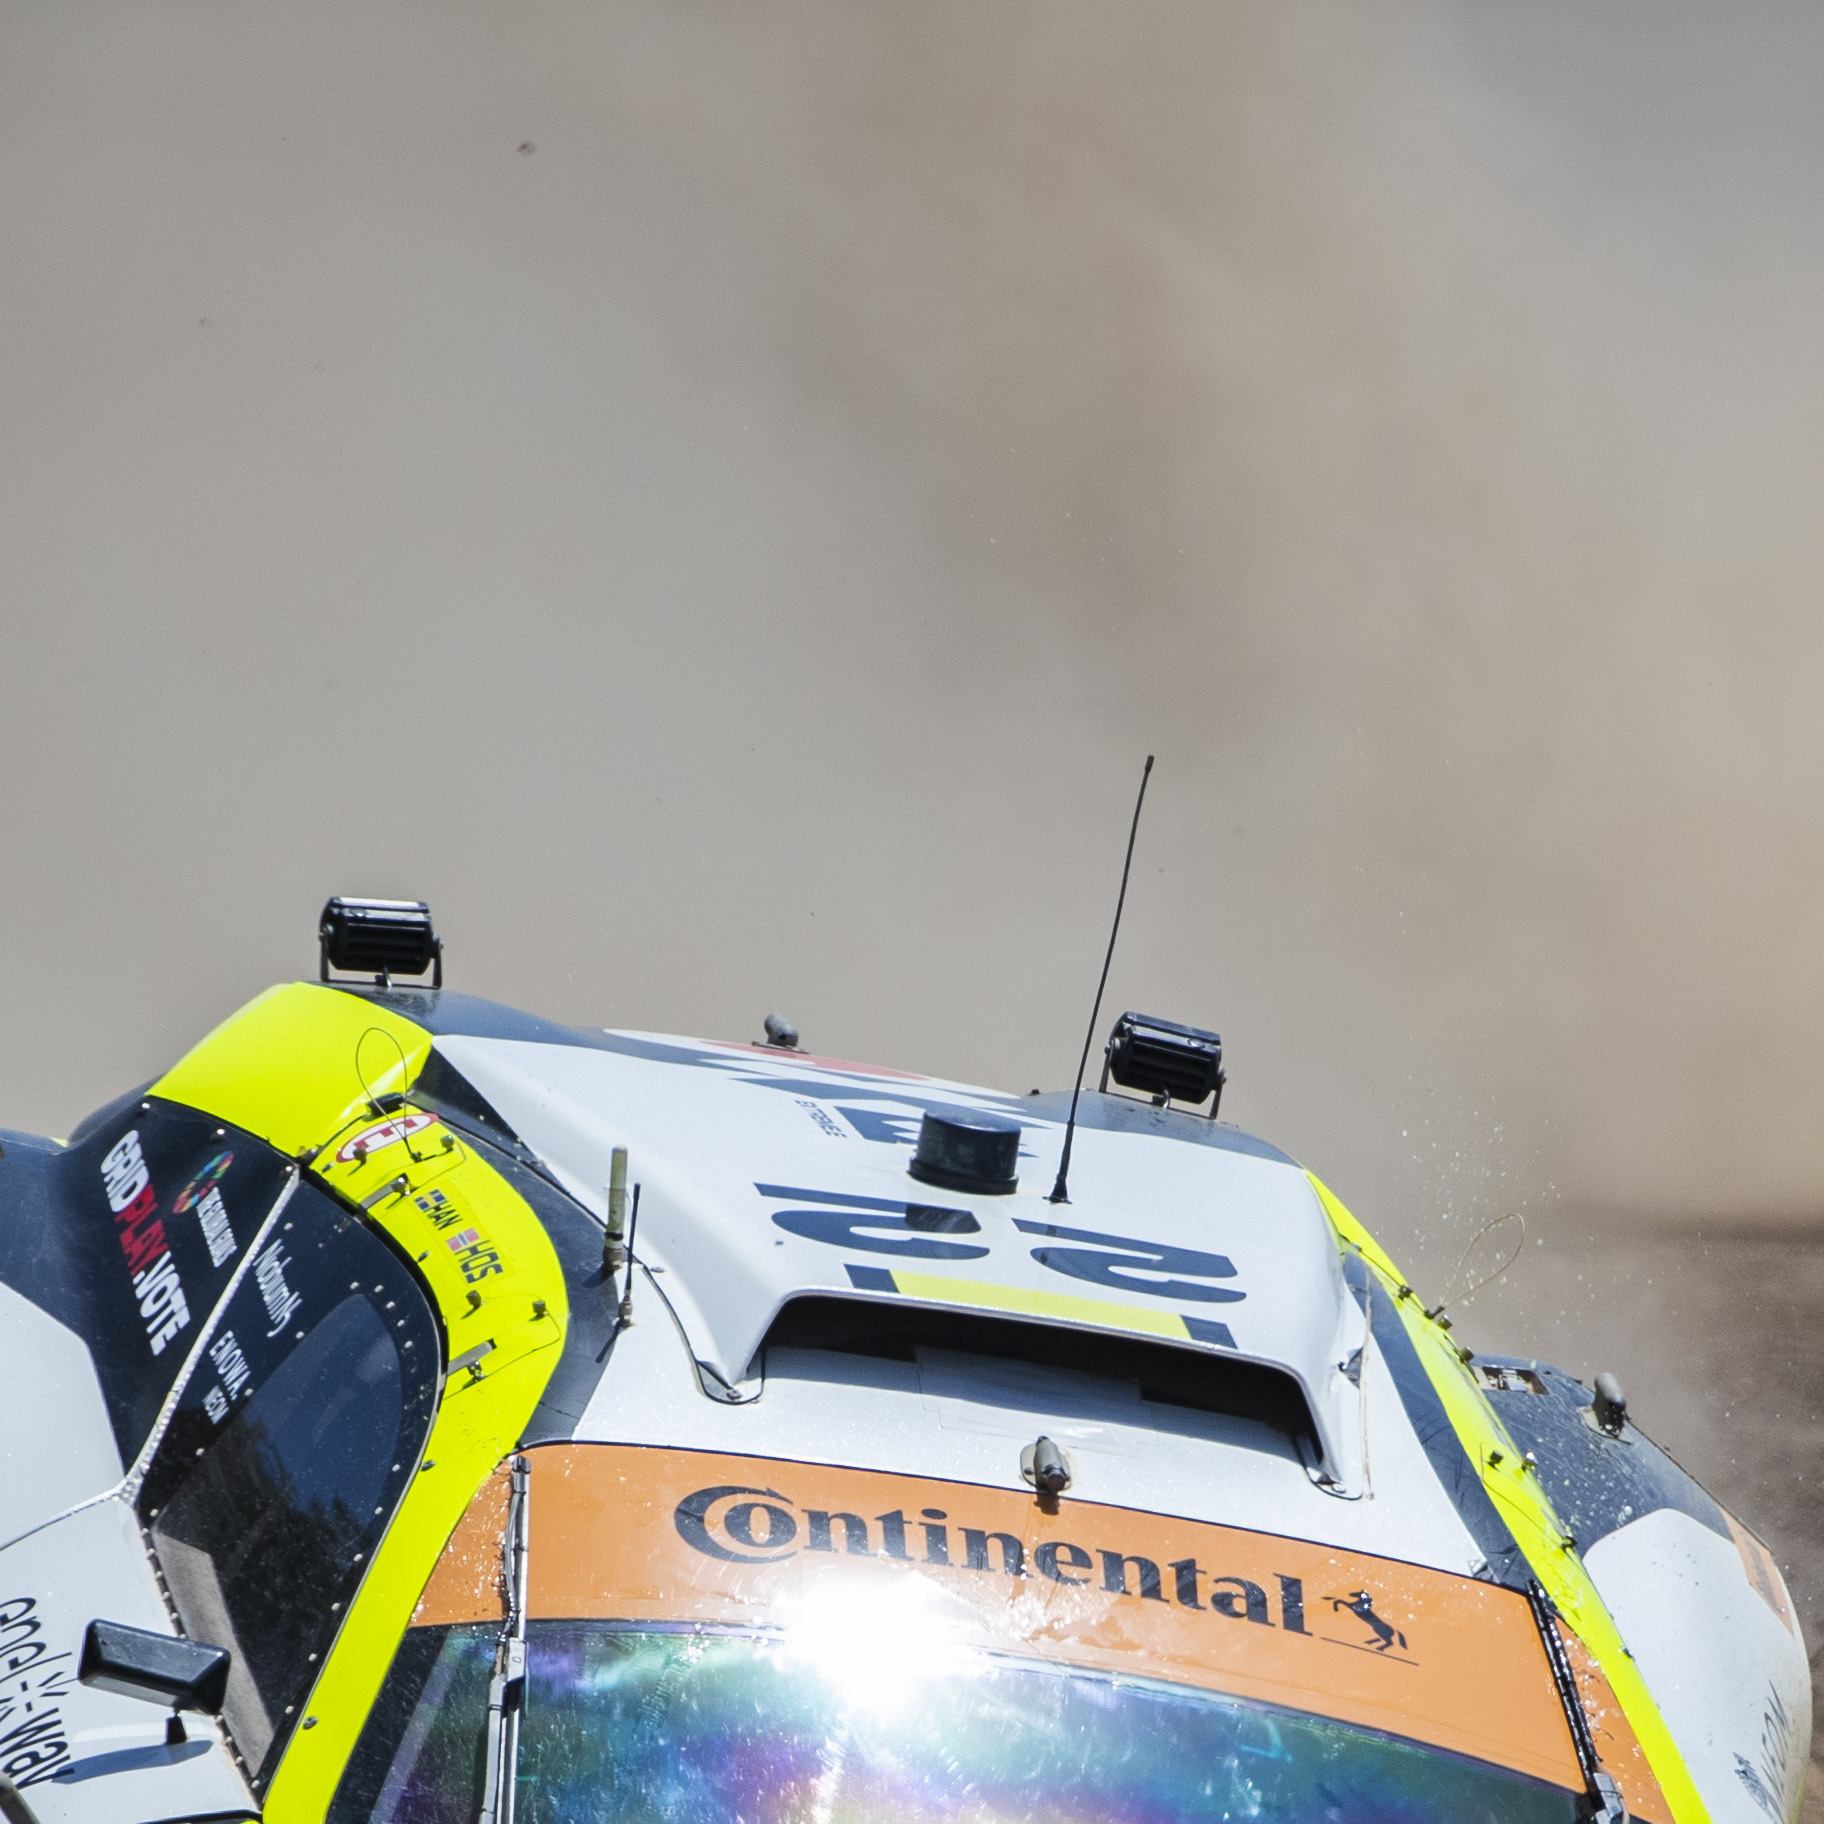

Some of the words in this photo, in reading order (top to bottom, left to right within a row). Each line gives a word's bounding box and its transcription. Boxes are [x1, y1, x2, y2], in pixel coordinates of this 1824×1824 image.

[428, 1202, 463, 1231] HAN
[454, 1240, 503, 1284] HOS
[202, 1385, 229, 1424] NEOM
[674, 1484, 1314, 1636] Continental
